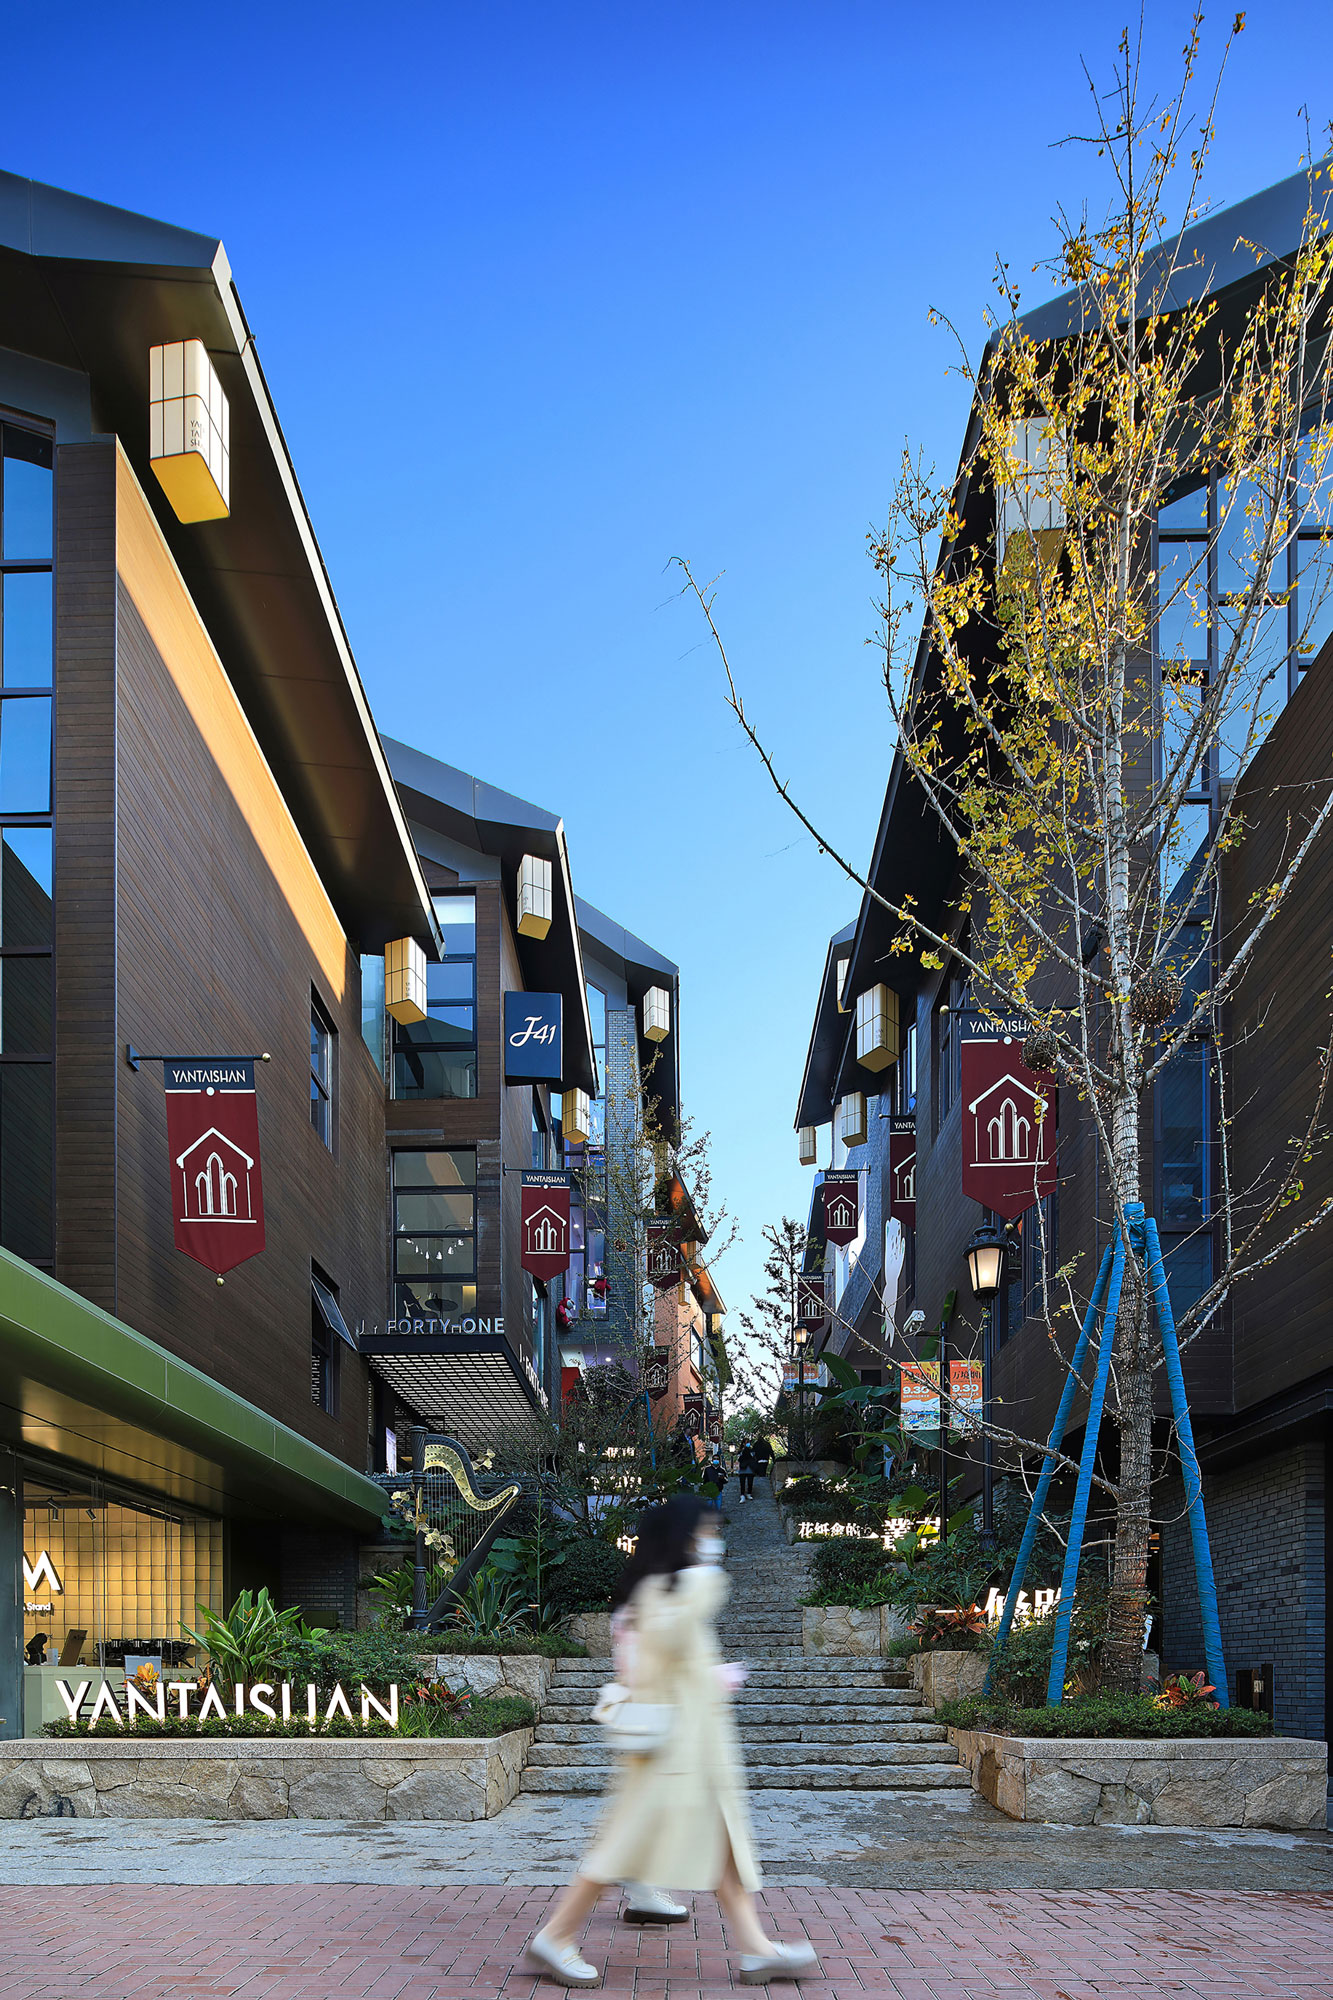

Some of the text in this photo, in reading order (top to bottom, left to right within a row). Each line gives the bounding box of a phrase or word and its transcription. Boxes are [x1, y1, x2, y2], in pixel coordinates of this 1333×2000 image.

[510, 1016, 557, 1047] J41
[969, 1020, 1038, 1034] YANTAISHA
[172, 1069, 247, 1083] YANTAISHAN
[525, 1174, 567, 1184] YANTAISHAN
[952, 1384, 979, 1393] 9.30
[27, 1602, 52, 1611] Stand
